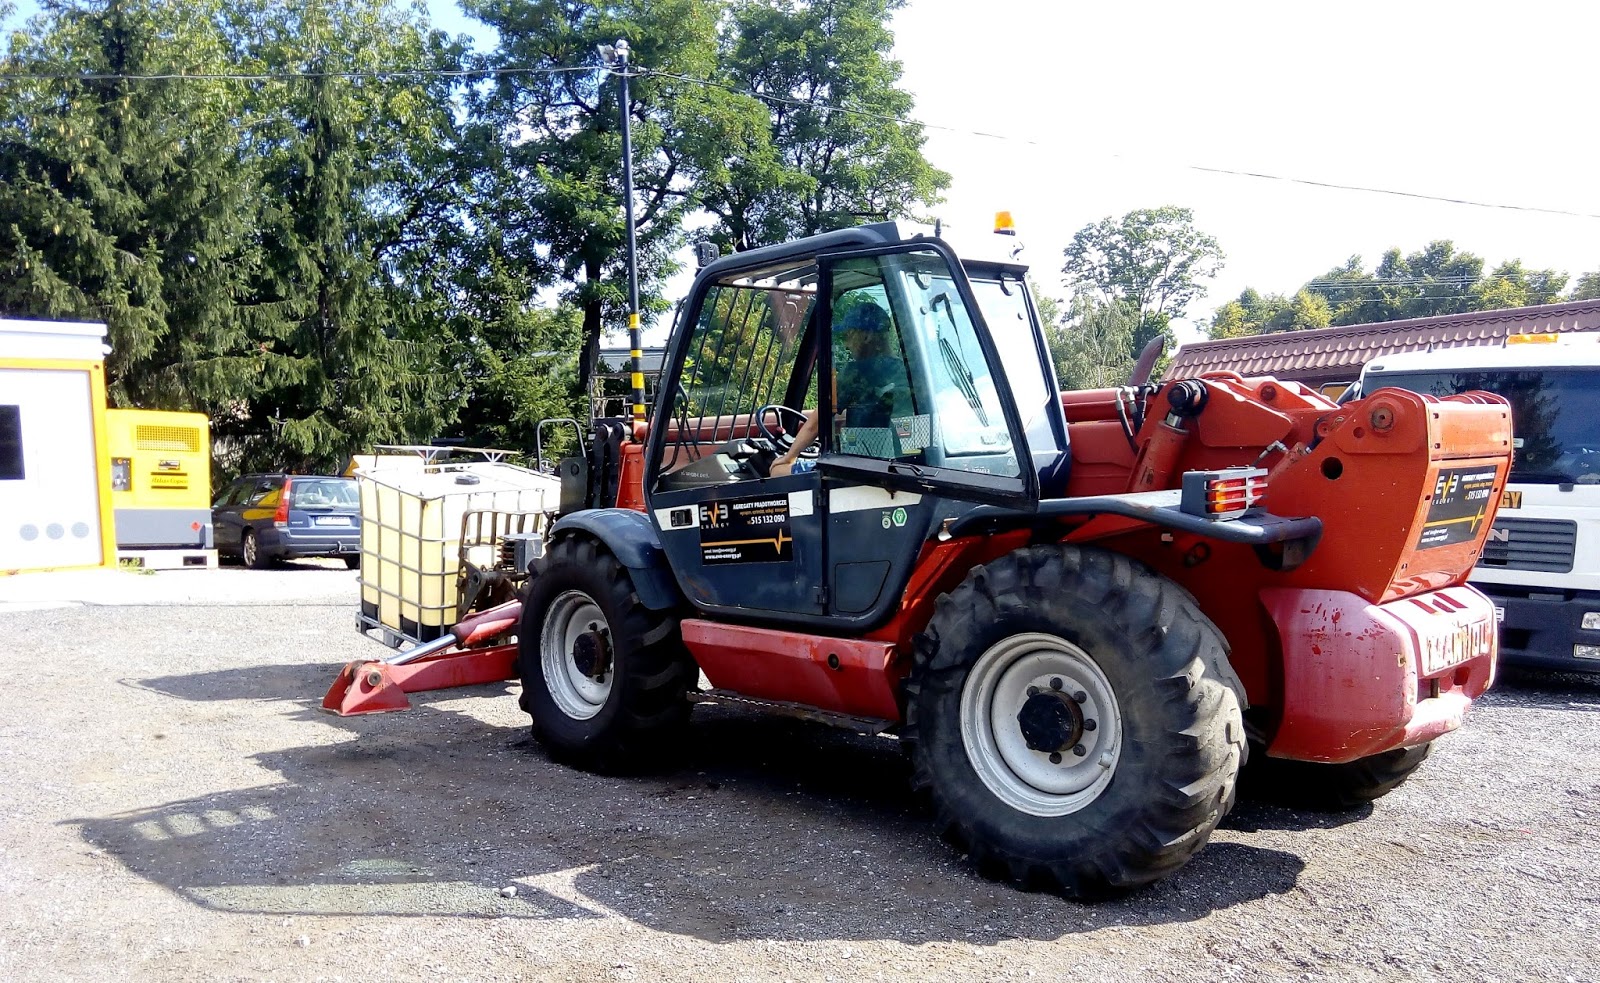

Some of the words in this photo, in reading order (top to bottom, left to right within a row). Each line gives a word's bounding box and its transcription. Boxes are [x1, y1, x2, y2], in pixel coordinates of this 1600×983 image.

[751, 515, 761, 525] 515
[762, 515, 773, 523] 132
[773, 514, 785, 523] 090
